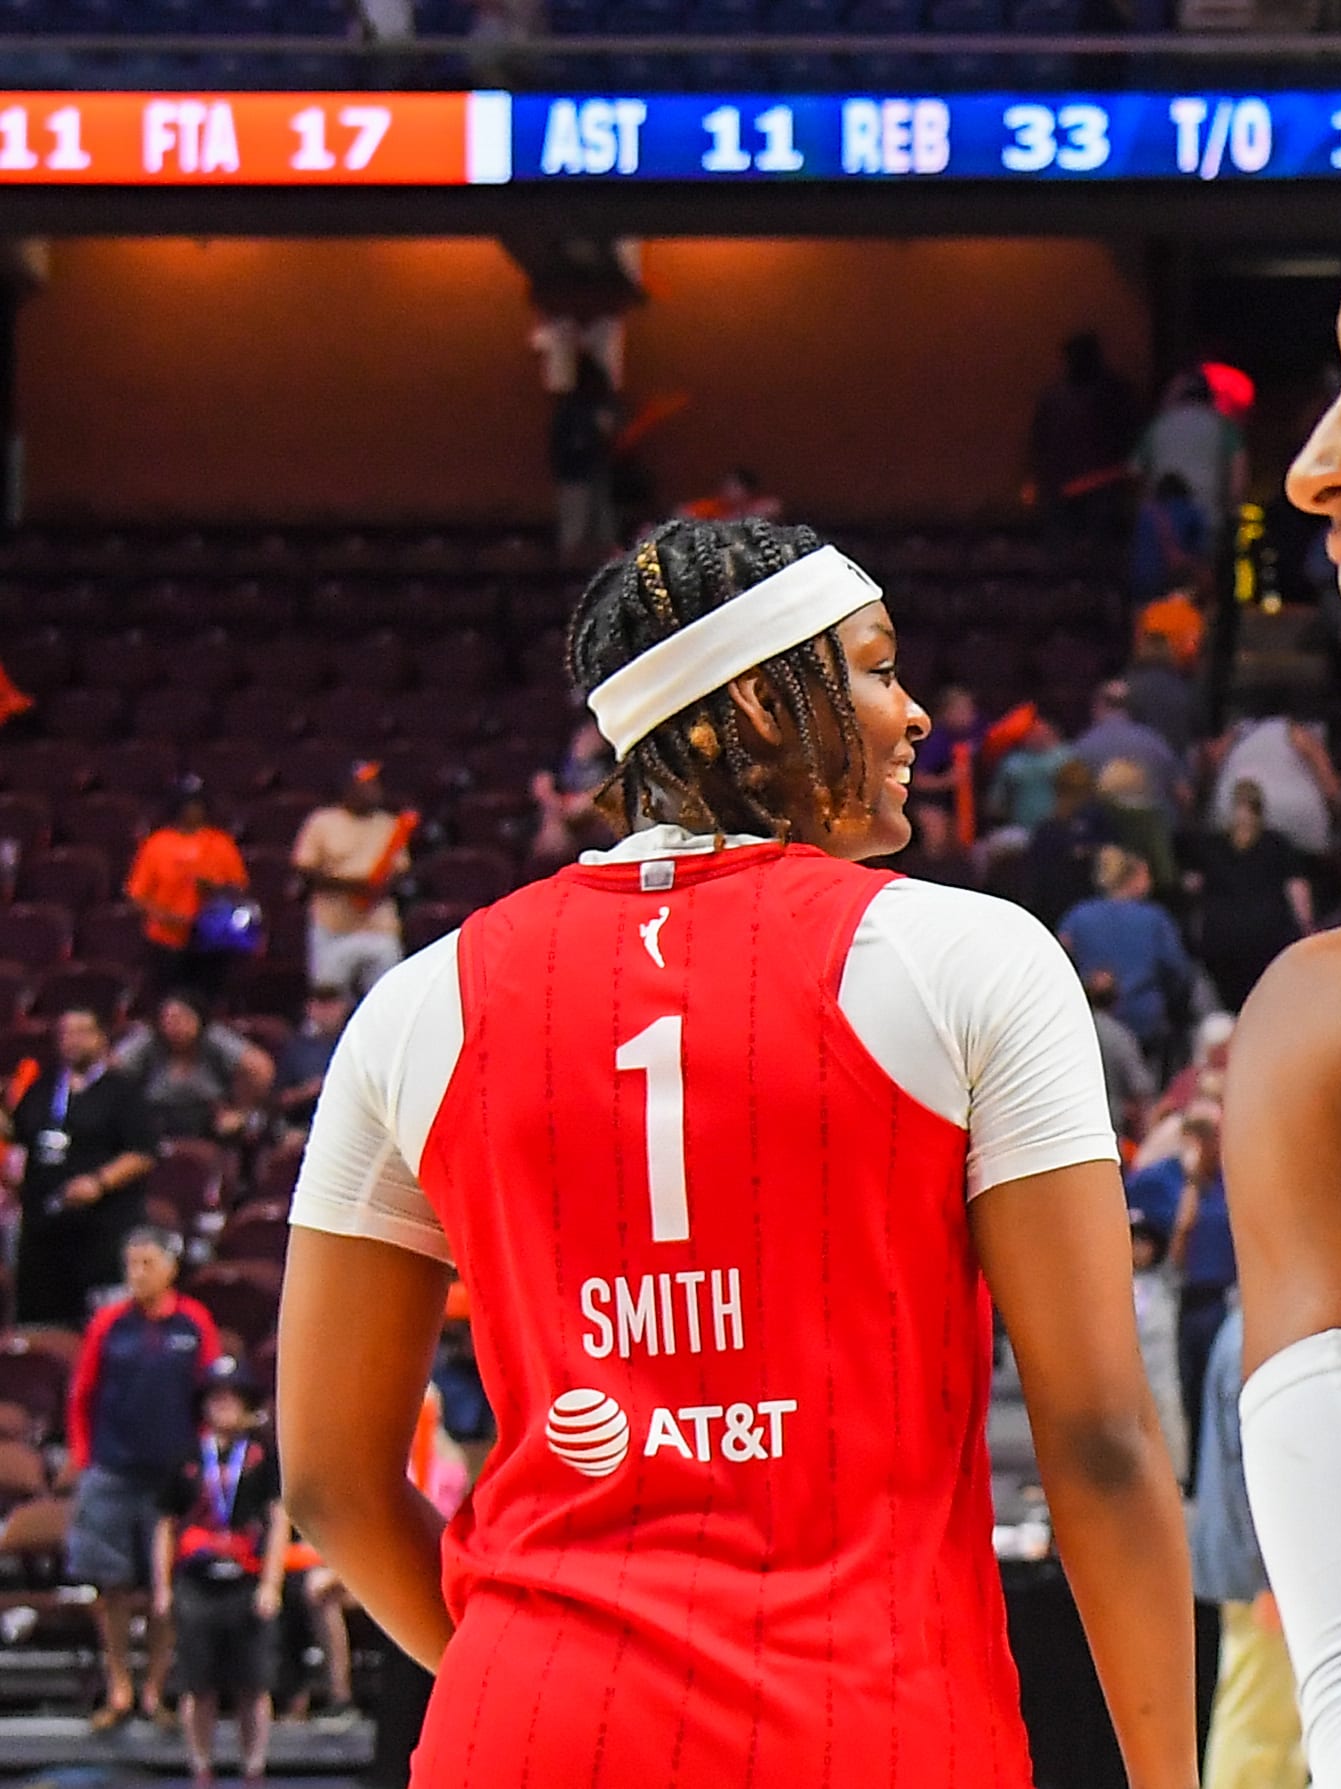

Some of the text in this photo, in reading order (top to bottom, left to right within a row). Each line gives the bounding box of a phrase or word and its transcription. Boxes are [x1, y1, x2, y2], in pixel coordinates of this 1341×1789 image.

[0, 98, 393, 174] 11 FTA 17
[541, 99, 647, 174] AST
[702, 105, 804, 172] 11
[842, 99, 950, 174] REB
[1002, 104, 1110, 171] 33
[1170, 98, 1272, 180] T/O
[615, 1014, 690, 1243] 1
[580, 1267, 744, 1359] SMITH
[643, 1399, 798, 1463] AT&T
